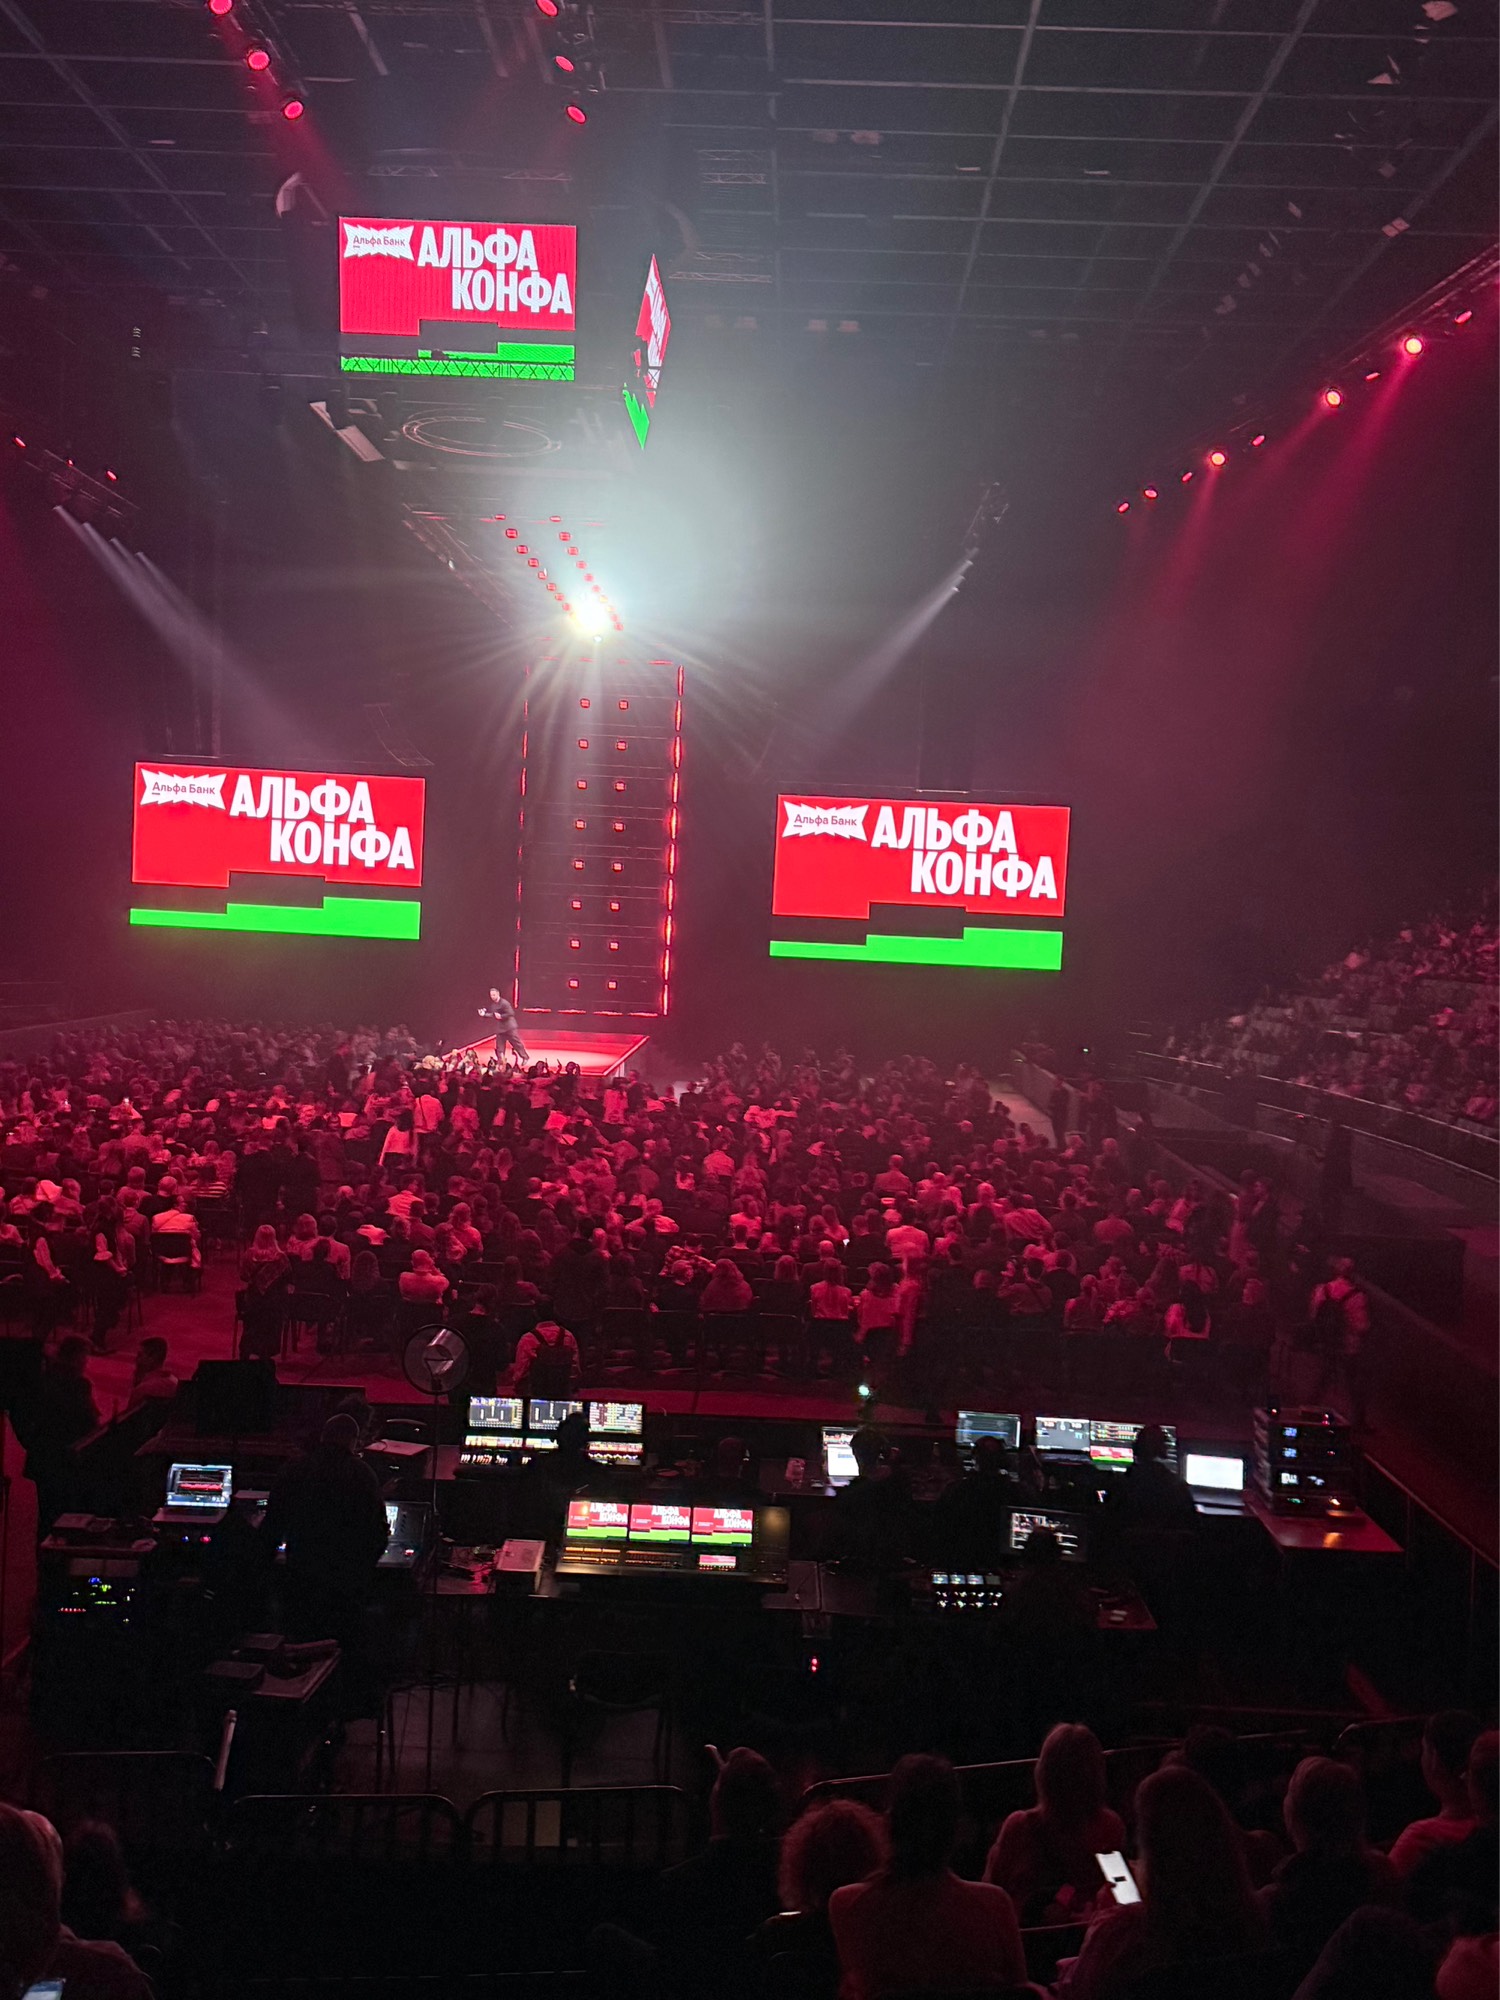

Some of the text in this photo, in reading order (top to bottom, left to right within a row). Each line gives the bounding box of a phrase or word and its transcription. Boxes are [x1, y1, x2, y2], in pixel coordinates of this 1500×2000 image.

[352, 235, 406, 247] Альфа Банк
[417, 226, 538, 271] АЛЬФА
[452, 269, 573, 314] КОНФА
[152, 781, 216, 795] Альфа Банк
[229, 774, 375, 824] АЛЬФА
[794, 814, 858, 827] Альфа Банк
[871, 805, 1018, 854] АЛЬФА
[270, 818, 415, 870] КОНФА
[911, 849, 1058, 899] КОНФА
